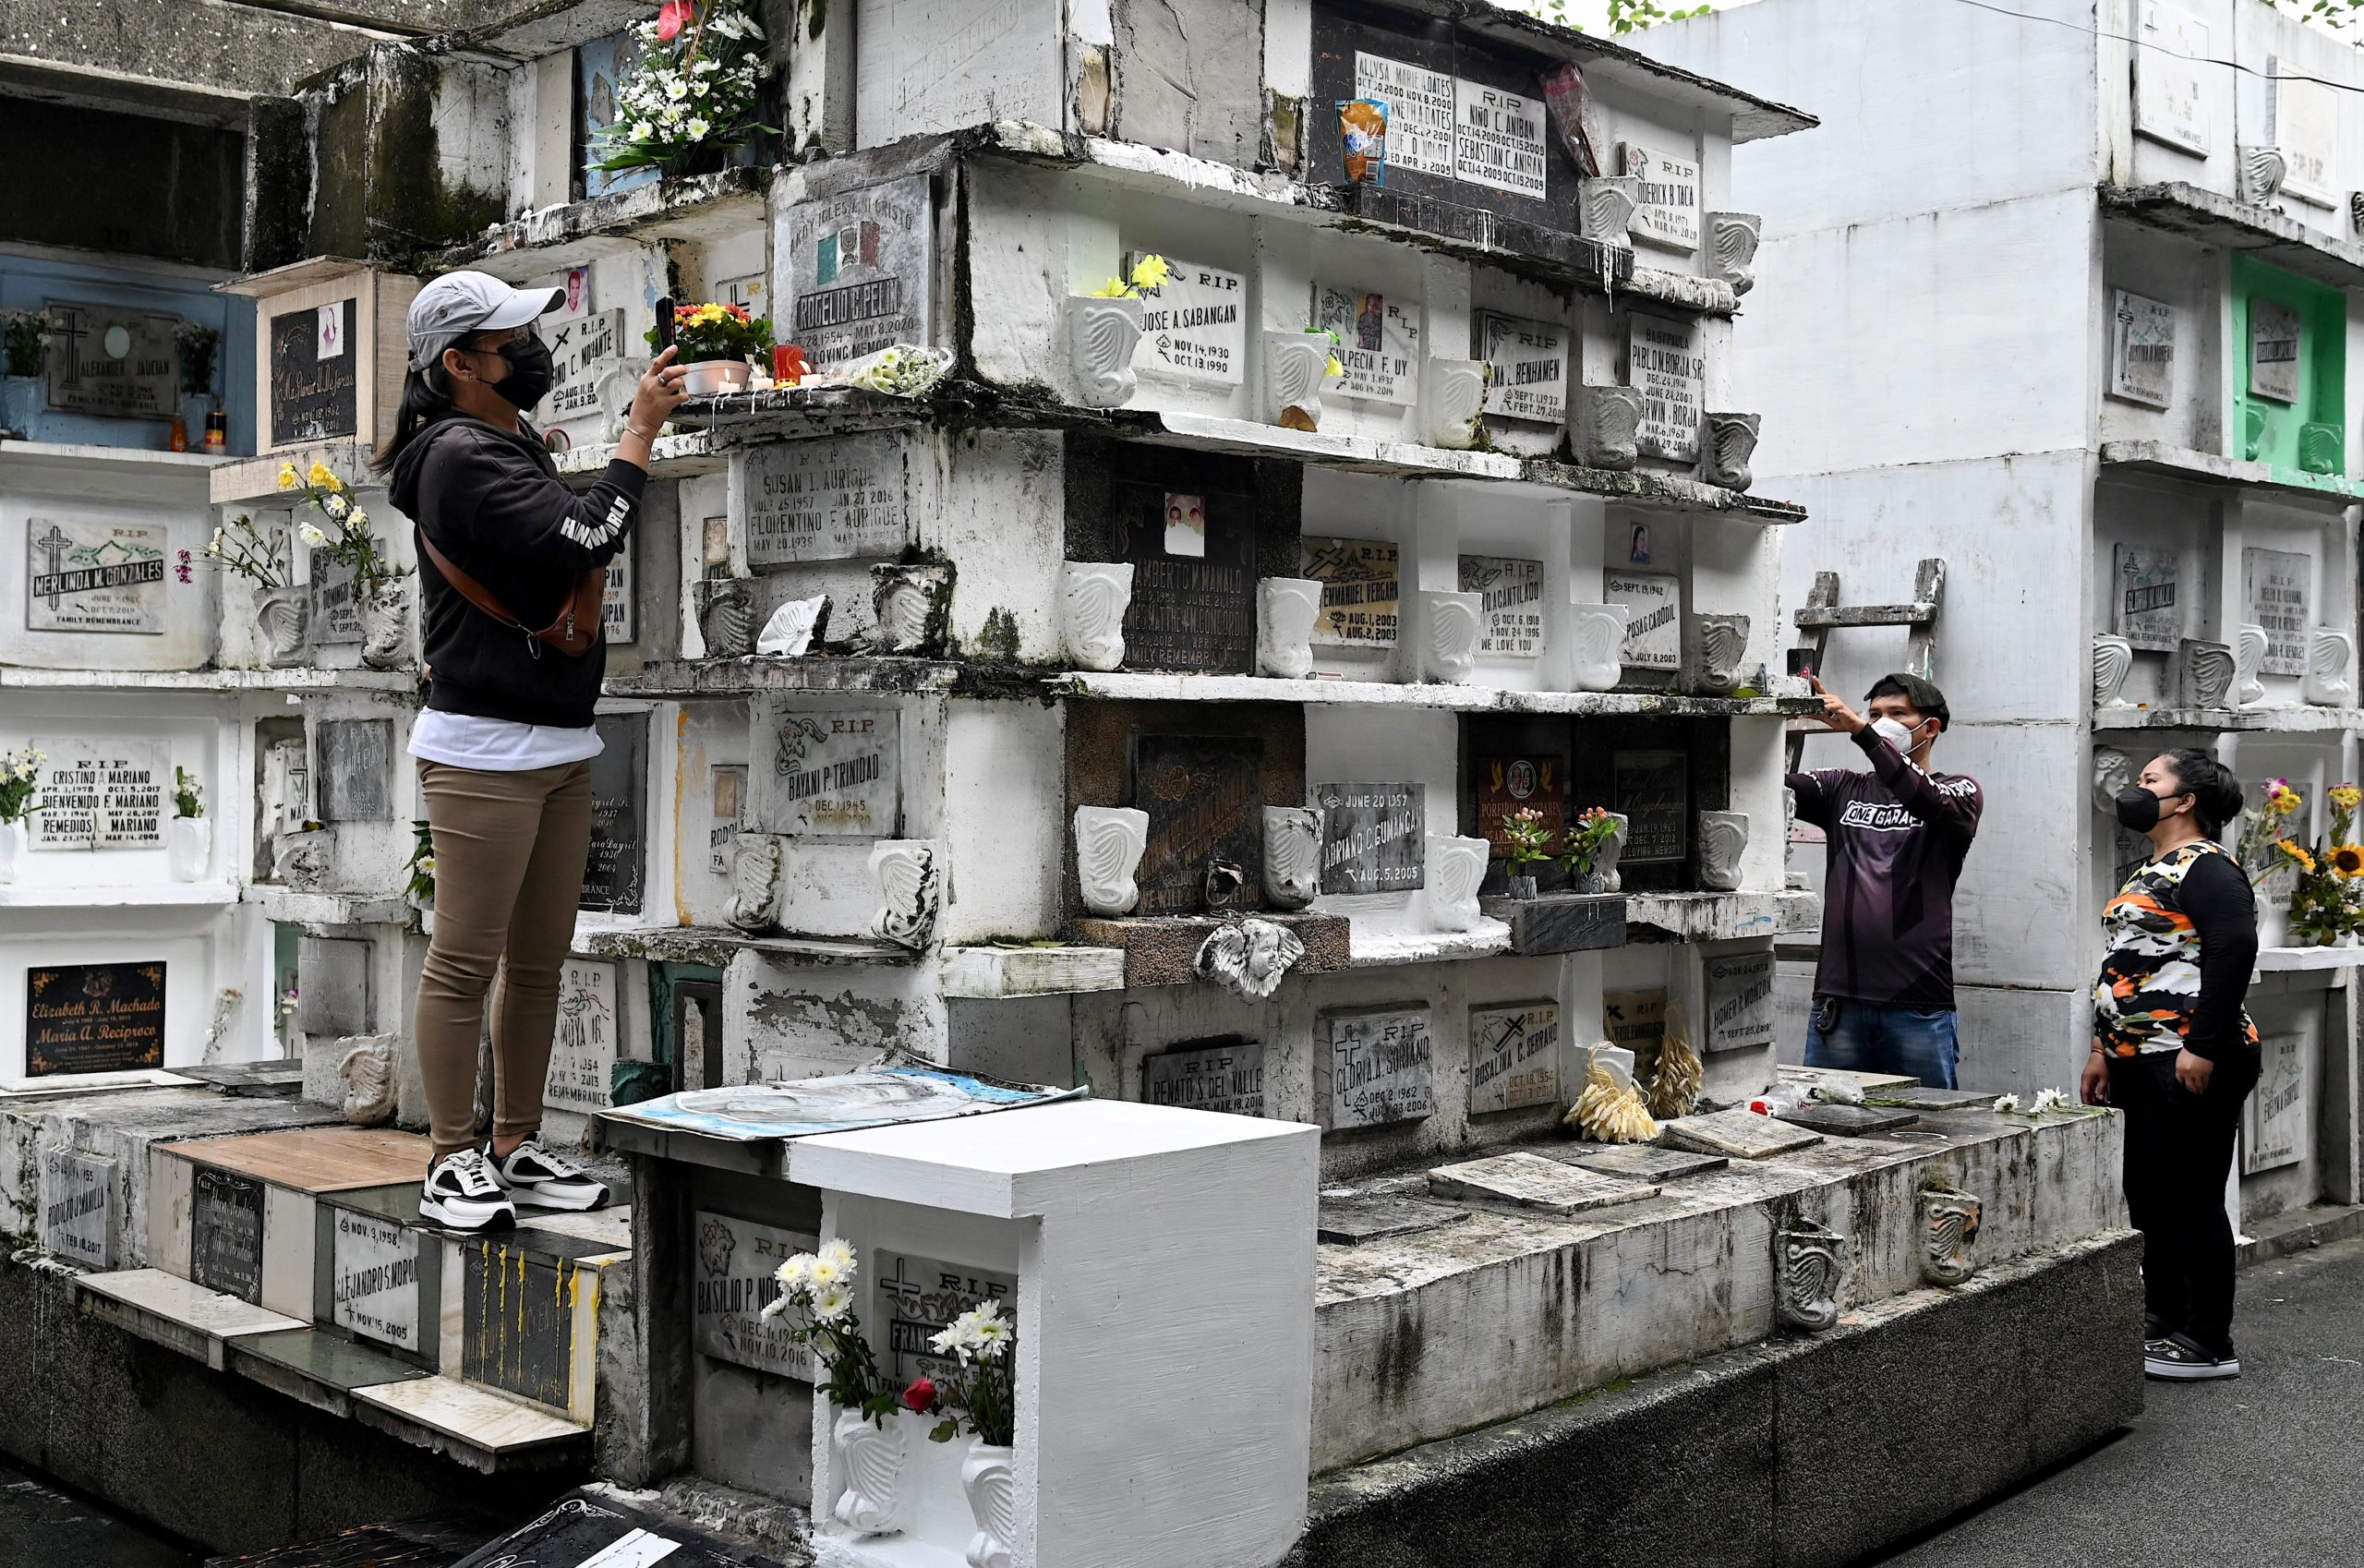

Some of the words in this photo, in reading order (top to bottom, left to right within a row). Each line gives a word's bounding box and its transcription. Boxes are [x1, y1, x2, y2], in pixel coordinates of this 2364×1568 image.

[1358, 56, 1389, 82] ALLYSA
[1505, 115, 1534, 140] ANIBAN
[1459, 139, 1503, 168] SEBASTIAN
[1635, 182, 1667, 206] ODERICK
[1677, 185, 1694, 207] TACA
[800, 289, 848, 331] ROGELIO
[1142, 311, 1168, 332] JOSE
[1184, 304, 1236, 328] SABANGAN
[813, 345, 849, 365] LOVING
[1395, 358, 1407, 377] UY
[1516, 358, 1559, 385] BENHAMEN
[1642, 398, 1665, 424] RWIN
[1673, 404, 1697, 429] BORJA
[764, 473, 802, 496] SUSAN
[751, 512, 822, 536] FLORENTINO
[35, 572, 90, 596] MERLINDA
[106, 561, 162, 585] GONZALES
[1323, 585, 1364, 608] EMMANUEL
[86, 617, 140, 625] REMEMBRANCE
[1125, 646, 1154, 663] AMILY
[1481, 639, 1491, 650] WE
[1497, 639, 1514, 650] LOVE
[1518, 640, 1531, 650] YOU
[1635, 653, 1650, 662] JULY
[54, 770, 95, 785] CRISTINO
[108, 770, 150, 784] MARIANO
[789, 769, 820, 802] BAYANI
[834, 754, 879, 790] TRINIDAD
[42, 795, 99, 809] BIENVENIDO
[115, 794, 159, 808] MARIANO
[1345, 794, 1369, 808] JUNE
[1849, 805, 1874, 822] ONE
[43, 819, 92, 834] REMEDIOS
[111, 818, 157, 832] MARIANO
[1324, 832, 1363, 872] ADRIANO
[597, 863, 616, 873] 2004
[32, 1001, 86, 1019] Elizabeth
[106, 996, 161, 1014] Machado
[1713, 1000, 1737, 1030] HOMER
[1744, 975, 1771, 1006] MONZON
[36, 1028, 77, 1044] Maria
[97, 1024, 156, 1043] Reciproco
[561, 1018, 585, 1048] MOYA
[1387, 1035, 1429, 1075] SORIANO
[1475, 1049, 1512, 1089] ROSALINA
[1527, 1022, 1557, 1057] SERRANO
[549, 1085, 607, 1107] REMEMBRANCE
[1153, 1077, 1193, 1105] RENATO
[1209, 1076, 1226, 1099] DEL
[1232, 1068, 1261, 1095] VALLE
[1245, 1095, 1263, 1108] 2010
[698, 1278, 740, 1315] BASILIO
